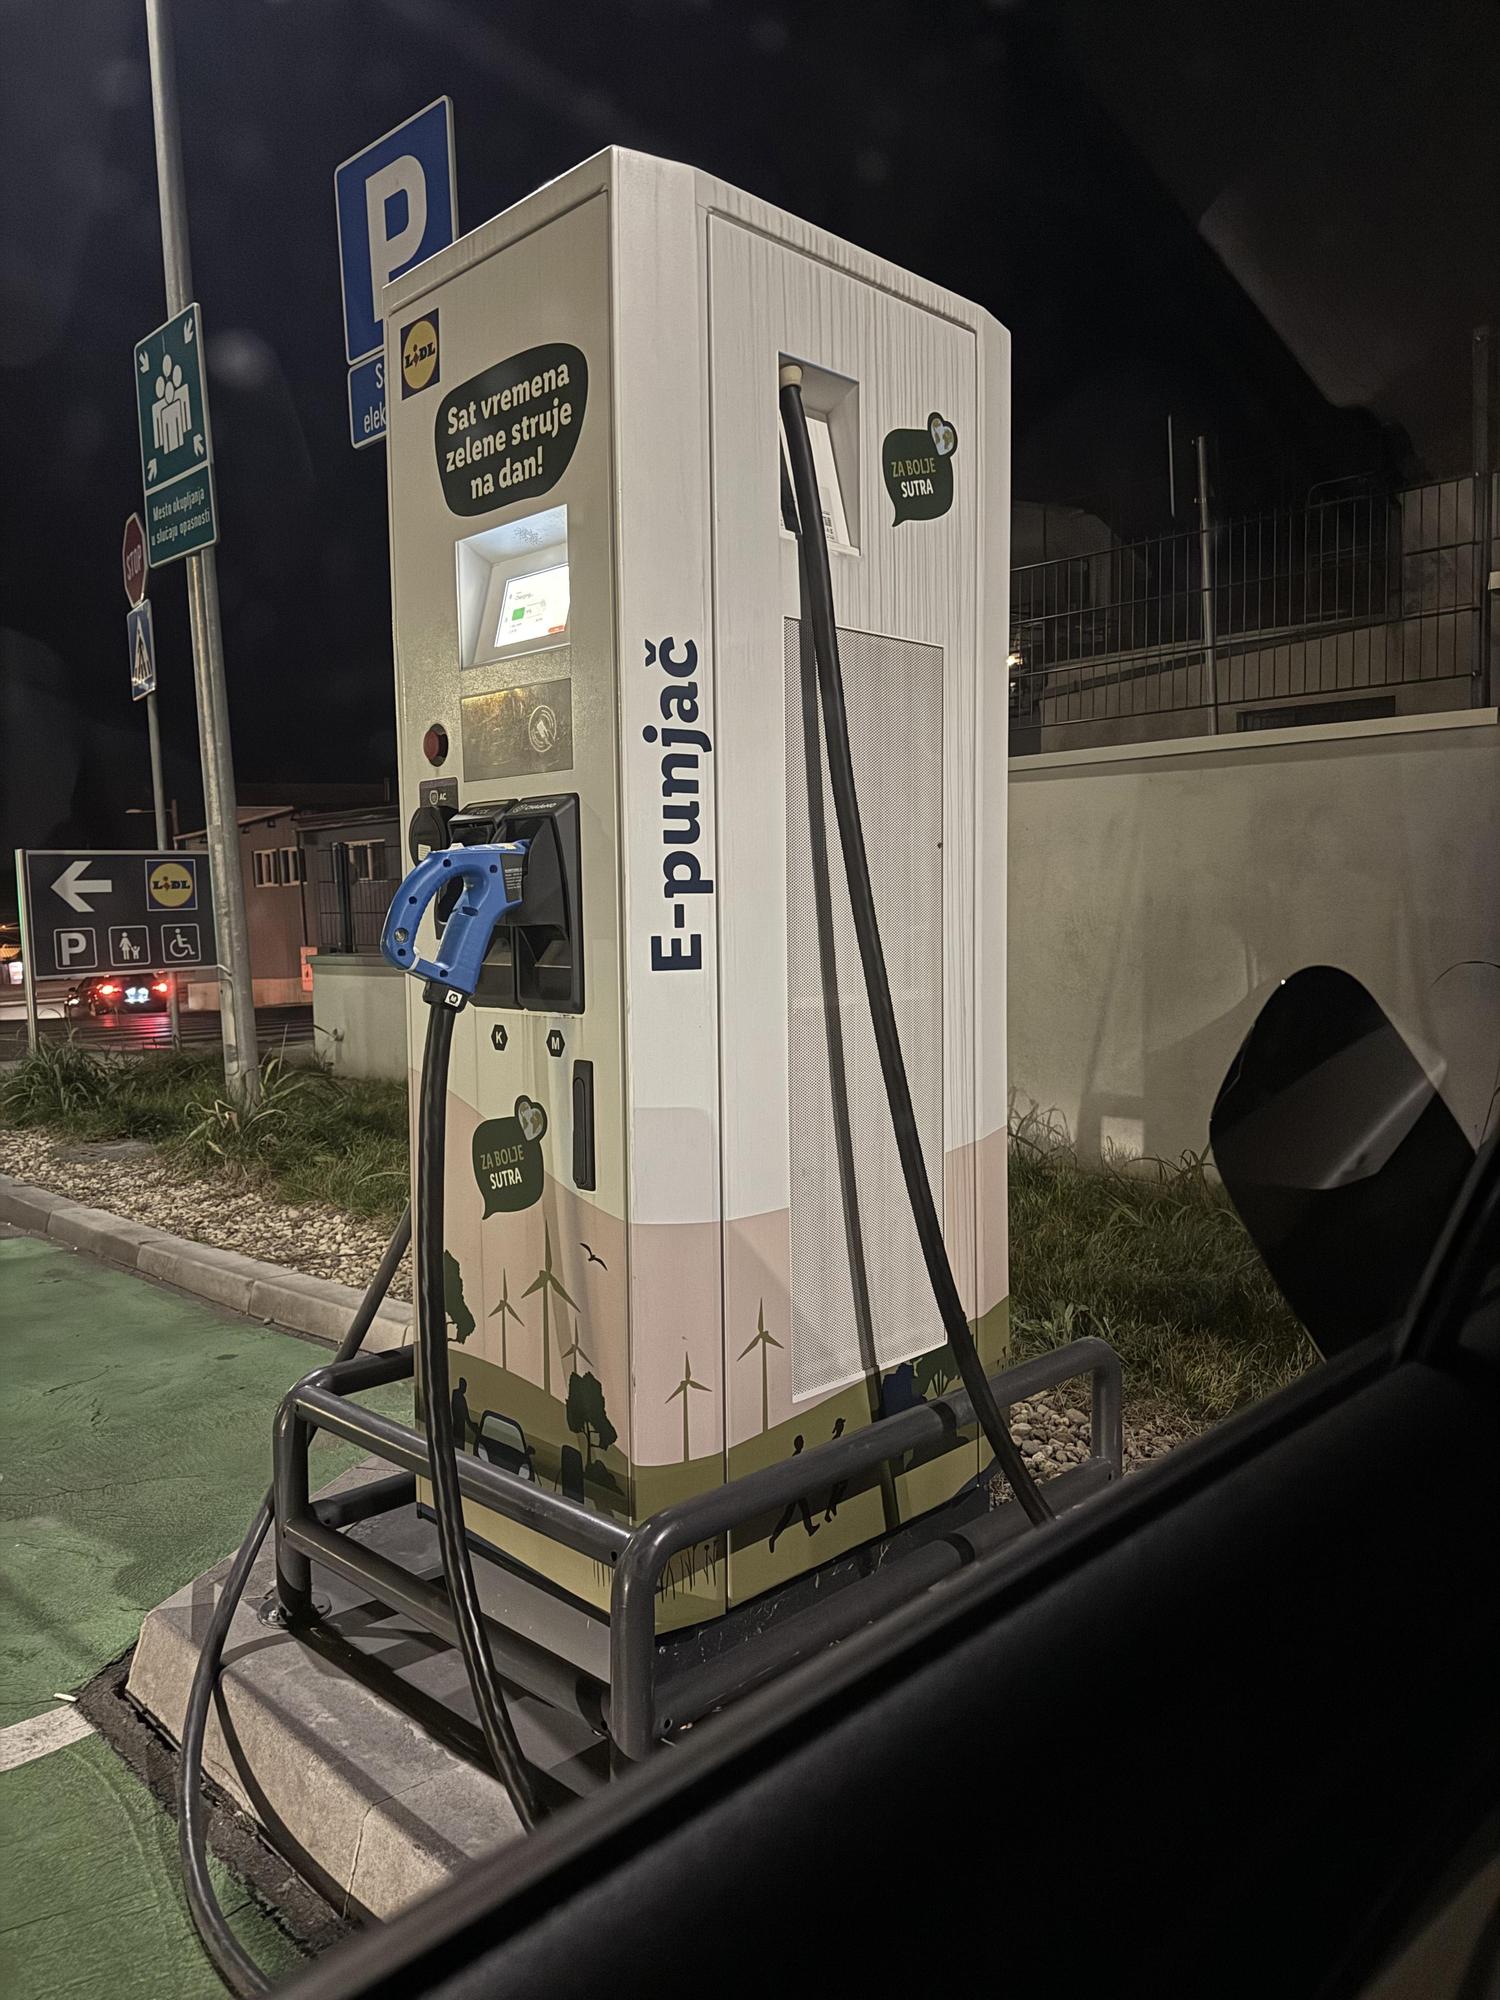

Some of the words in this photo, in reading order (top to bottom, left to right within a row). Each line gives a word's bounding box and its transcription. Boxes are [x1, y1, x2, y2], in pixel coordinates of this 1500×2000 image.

[365, 154, 427, 323] P
[375, 363, 385, 389] S
[447, 401, 478, 435] Sat
[480, 363, 570, 420] vremena
[446, 428, 506, 473] zelene
[511, 397, 573, 446] struje
[470, 473, 495, 500] na
[498, 446, 543, 489] dan!
[891, 460, 906, 478] ZA
[906, 457, 937, 476] BOLJE
[900, 478, 934, 498] SUTRA
[152, 503, 172, 521] Mesto
[173, 486, 205, 512] okupljanja
[180, 507, 211, 536] opasnosti
[126, 544, 142, 581] STOP
[439, 792, 447, 801] AC
[642, 636, 715, 972] E-punjač
[60, 932, 87, 966] P
[495, 1031, 503, 1044] K
[551, 1036, 560, 1050] M
[480, 1153, 494, 1170] ZA
[494, 1144, 525, 1167] BOLJE
[489, 1167, 523, 1190] SUTRA
